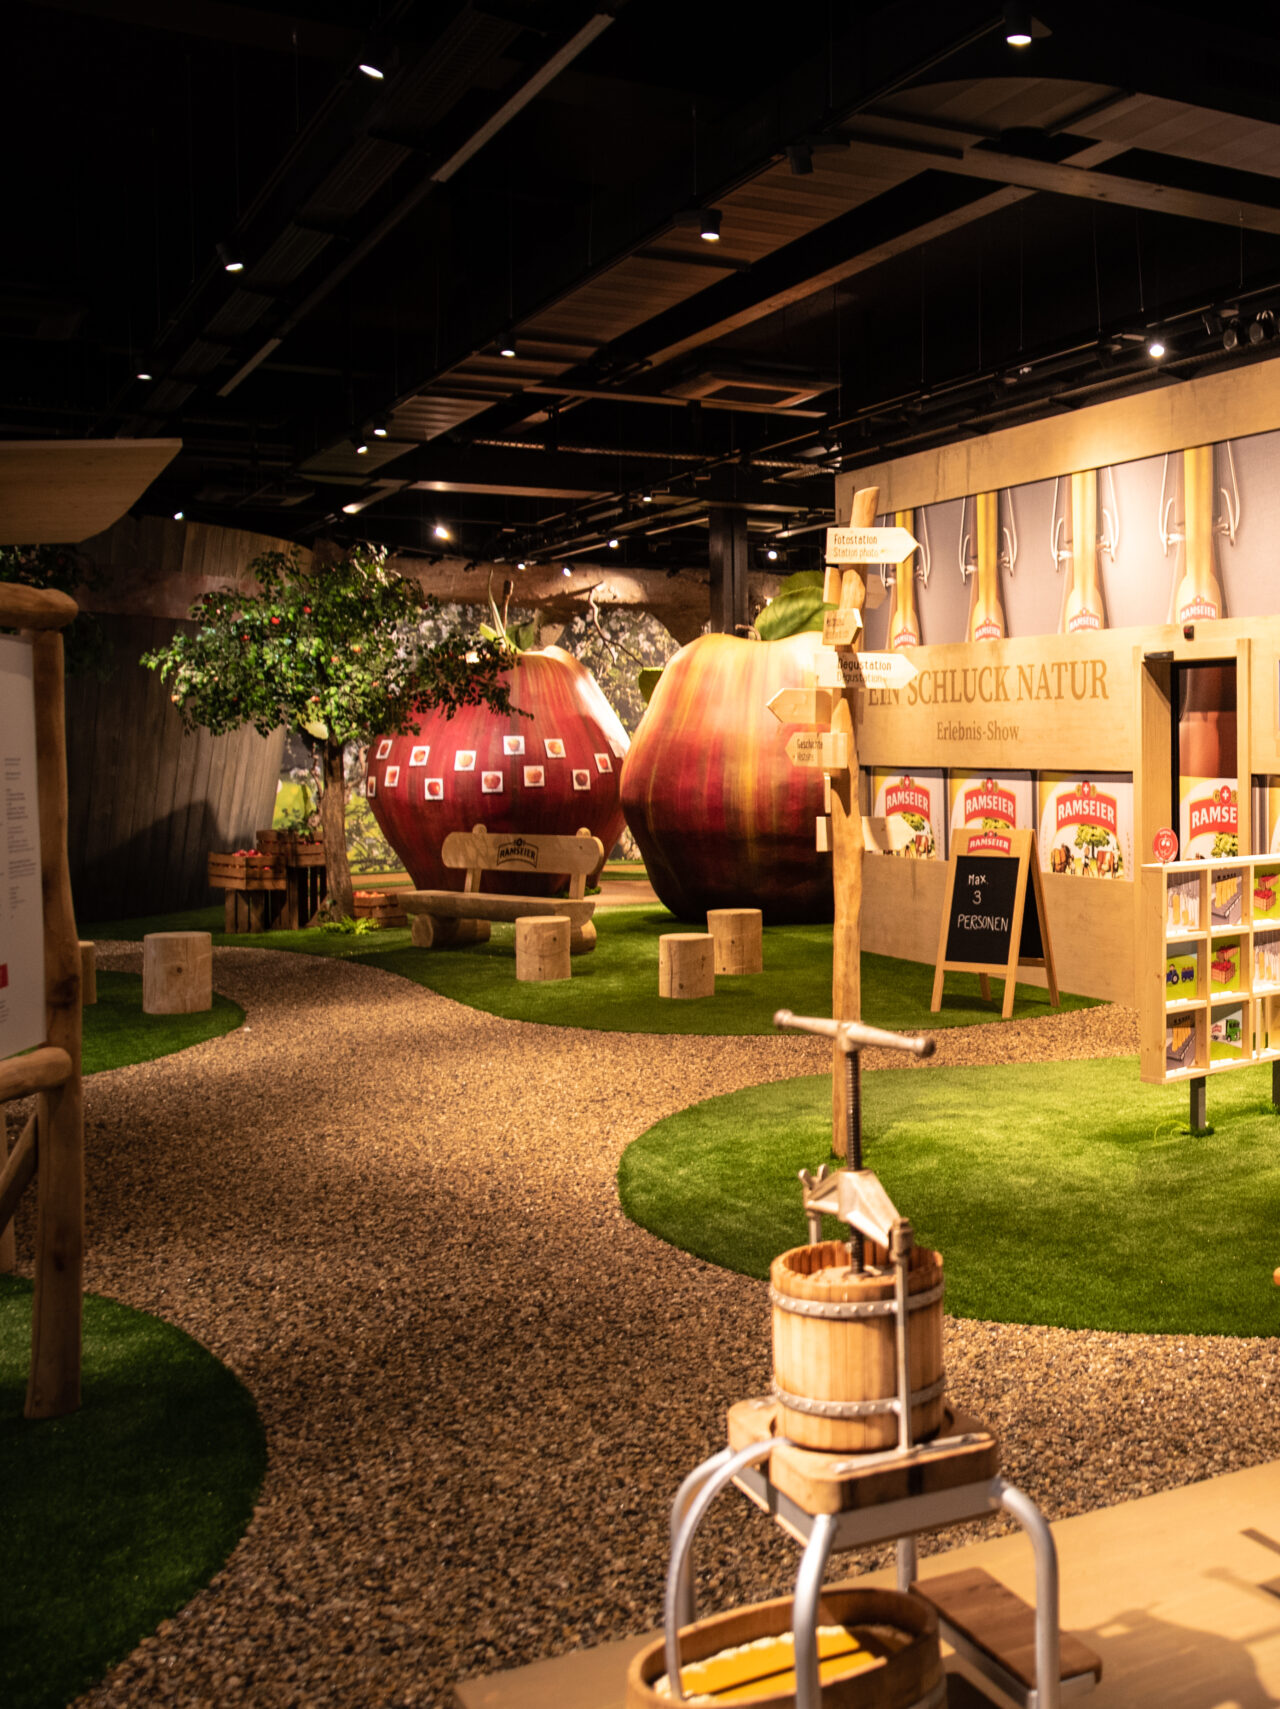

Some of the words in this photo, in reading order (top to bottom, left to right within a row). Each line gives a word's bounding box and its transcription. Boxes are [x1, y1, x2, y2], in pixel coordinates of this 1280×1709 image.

[1180, 605, 1216, 621] RAMSEIER
[908, 665, 1011, 706] SCHLUCK
[1016, 659, 1109, 702] NATUR
[937, 719, 1020, 741] Erlebnis-Show
[886, 790, 929, 811] RAMSEIER
[966, 795, 1014, 818] RAMSEIER
[1057, 800, 1116, 824] RAMSEIER
[969, 837, 1009, 850] RAMSEIER
[972, 889, 981, 905] 3
[957, 913, 1009, 932] PERSONEN
